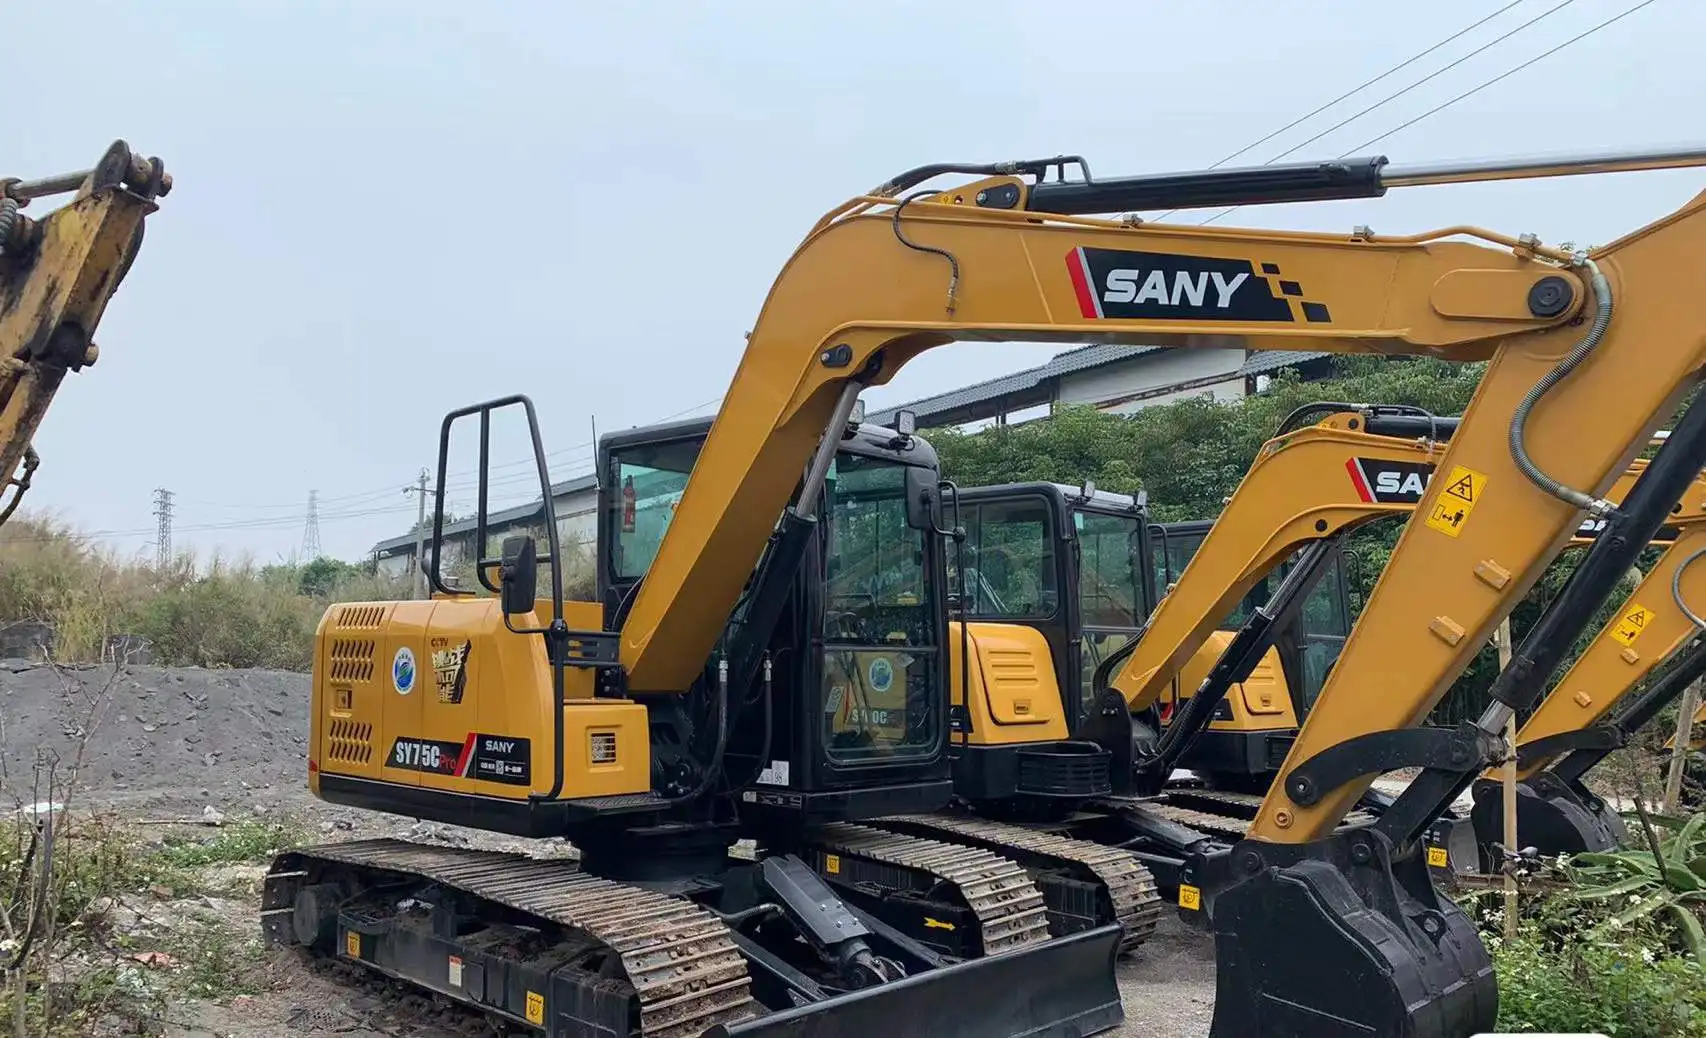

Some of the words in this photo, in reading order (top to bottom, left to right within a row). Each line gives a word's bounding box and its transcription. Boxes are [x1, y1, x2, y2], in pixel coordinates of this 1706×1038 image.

[1104, 268, 1250, 308] SANY
[1376, 471, 1432, 495] SA
[396, 741, 440, 768] SY75C
[485, 740, 515, 754] SANY
